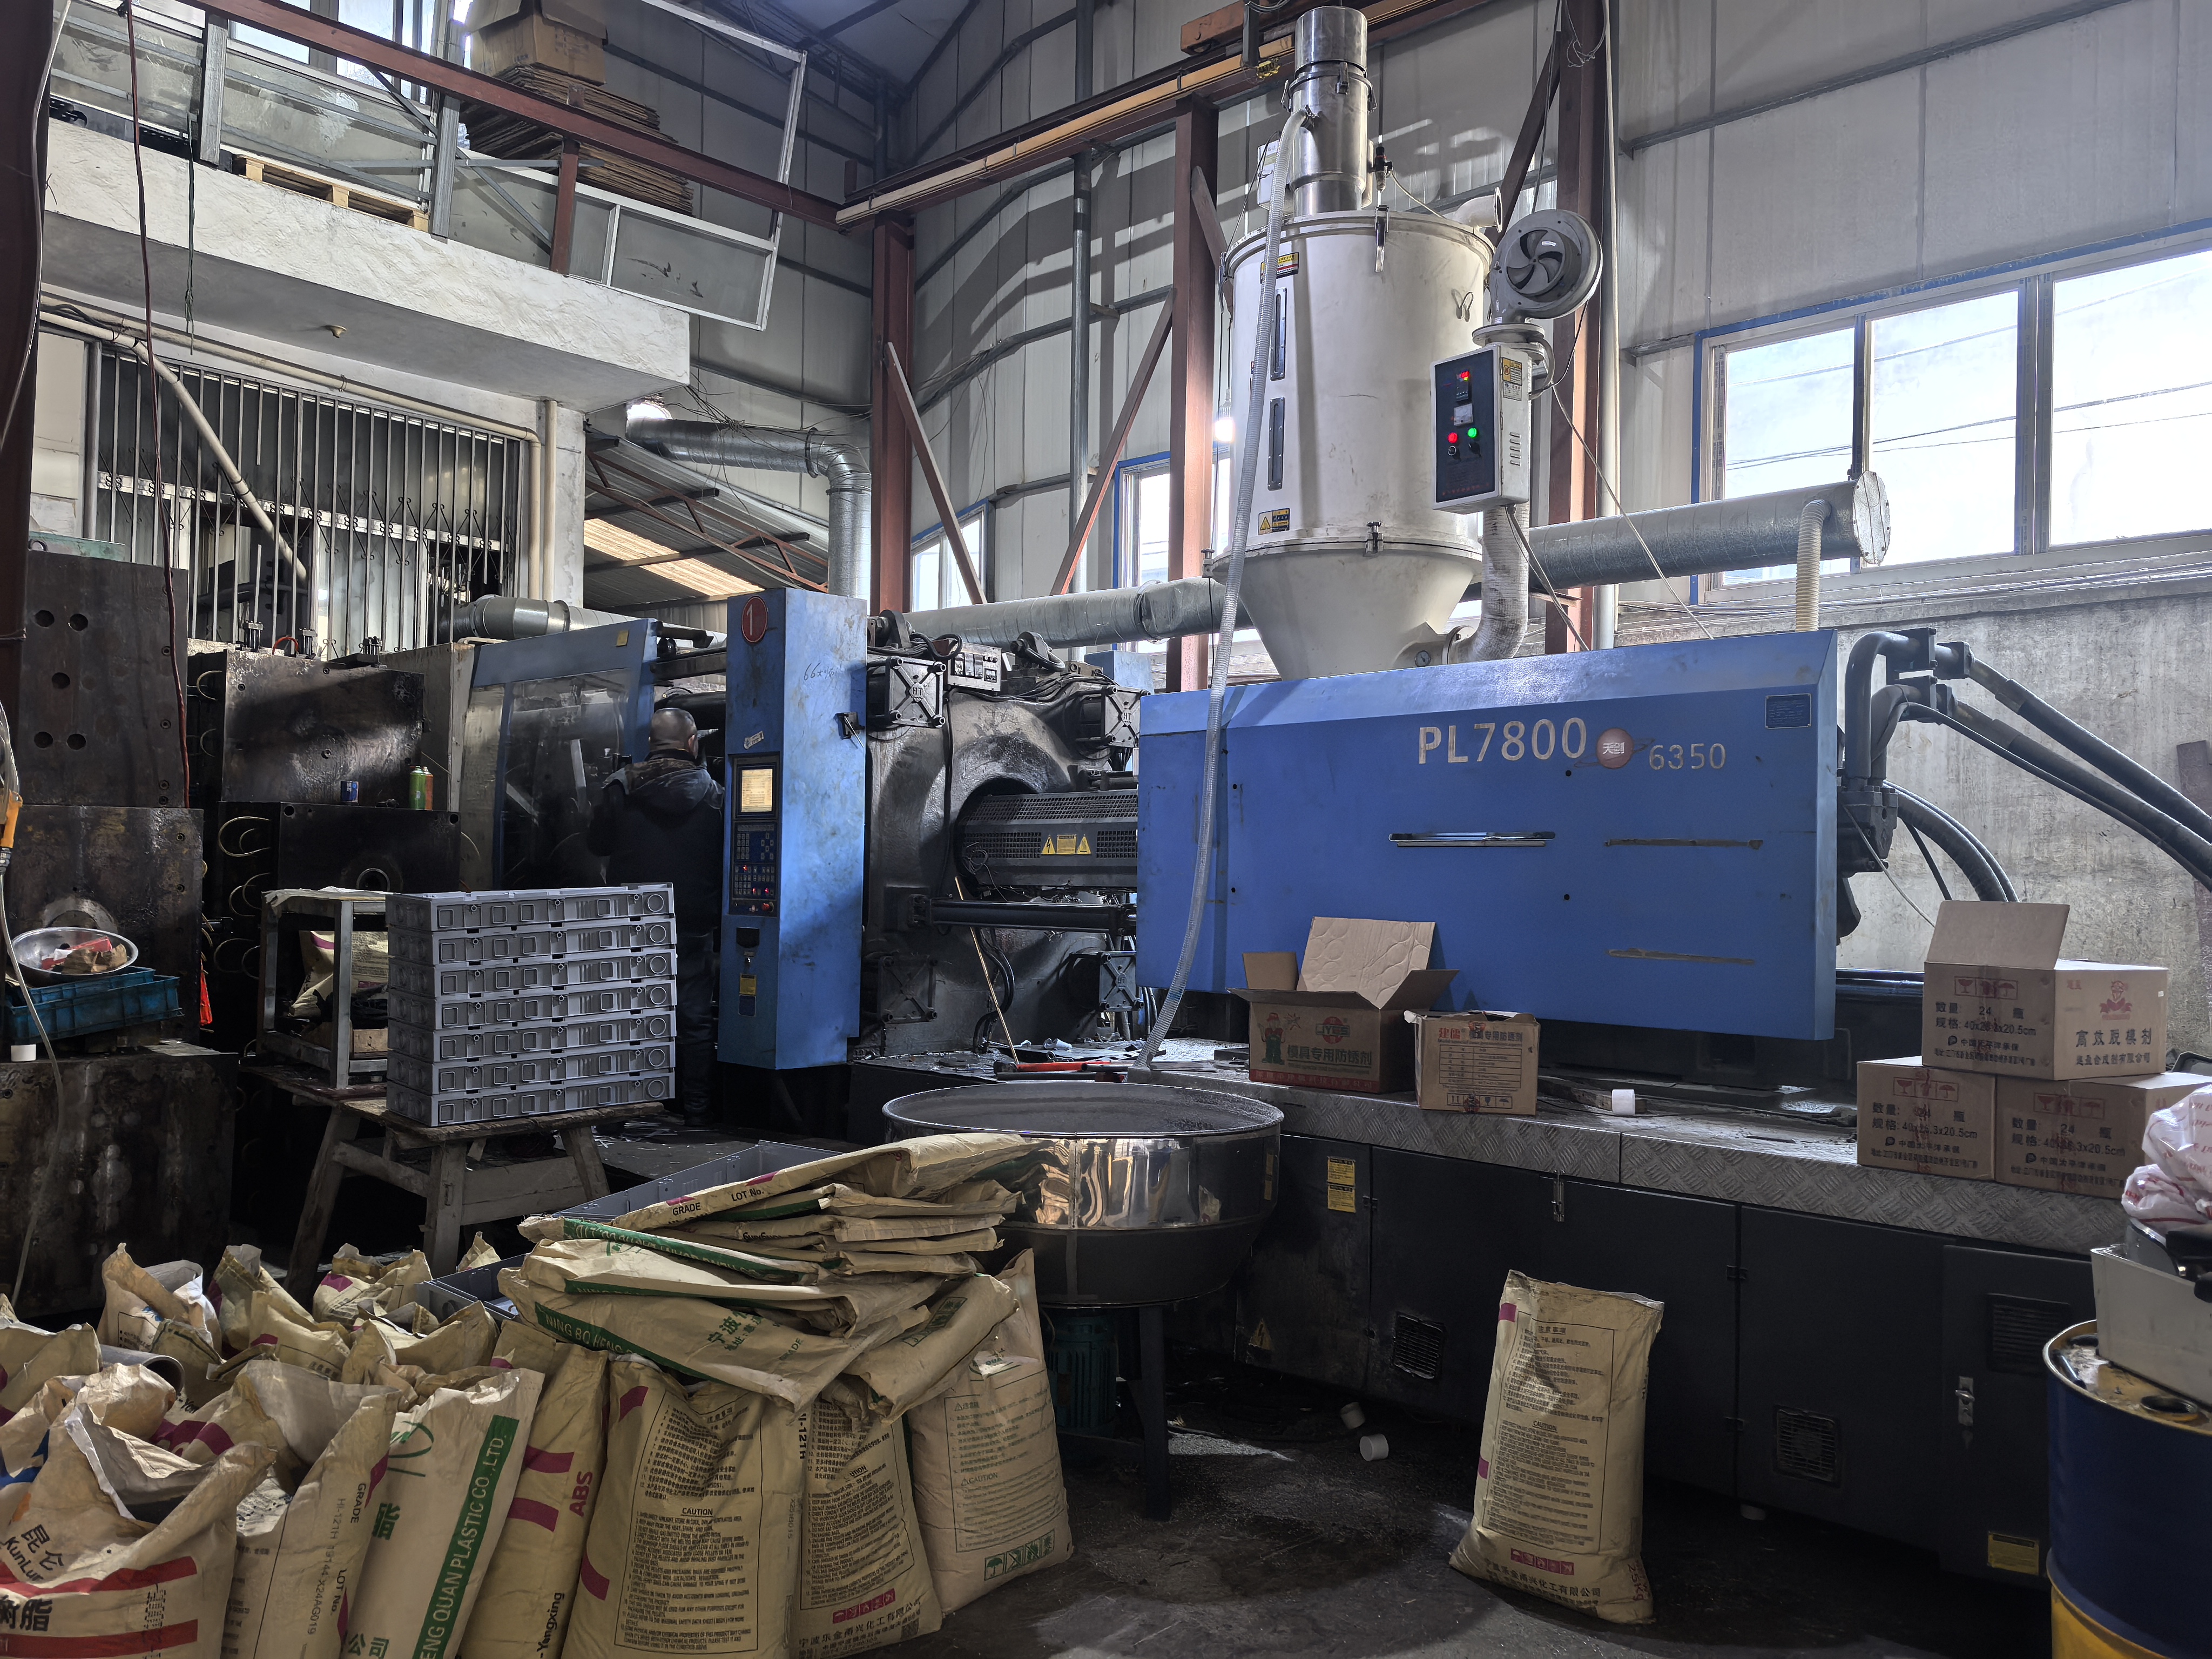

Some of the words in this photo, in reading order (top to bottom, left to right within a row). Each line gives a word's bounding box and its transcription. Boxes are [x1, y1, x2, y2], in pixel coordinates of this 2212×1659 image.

[746, 604, 753, 636] 1
[1418, 717, 1587, 765] PL7800
[1649, 743, 1727, 771] 6350
[1979, 1006, 1992, 1016] 24
[731, 1191, 748, 1202] LOT
[750, 1187, 764, 1197] No.
[673, 1202, 701, 1216] GRADE
[545, 1314, 573, 1337] NING
[575, 1326, 592, 1345] BO
[1532, 1419, 1557, 1431] CAUTION
[968, 1472, 999, 1485] CAUTION
[351, 1482, 367, 1524] GRADE
[569, 1471, 593, 1518] ABS
[682, 1507, 713, 1515] CAUTION
[433, 1567, 463, 1622] QUAN
[453, 1502, 483, 1568] PLASTIC
[336, 1568, 347, 1592] LOT
[536, 1591, 565, 1653] Yongxing
